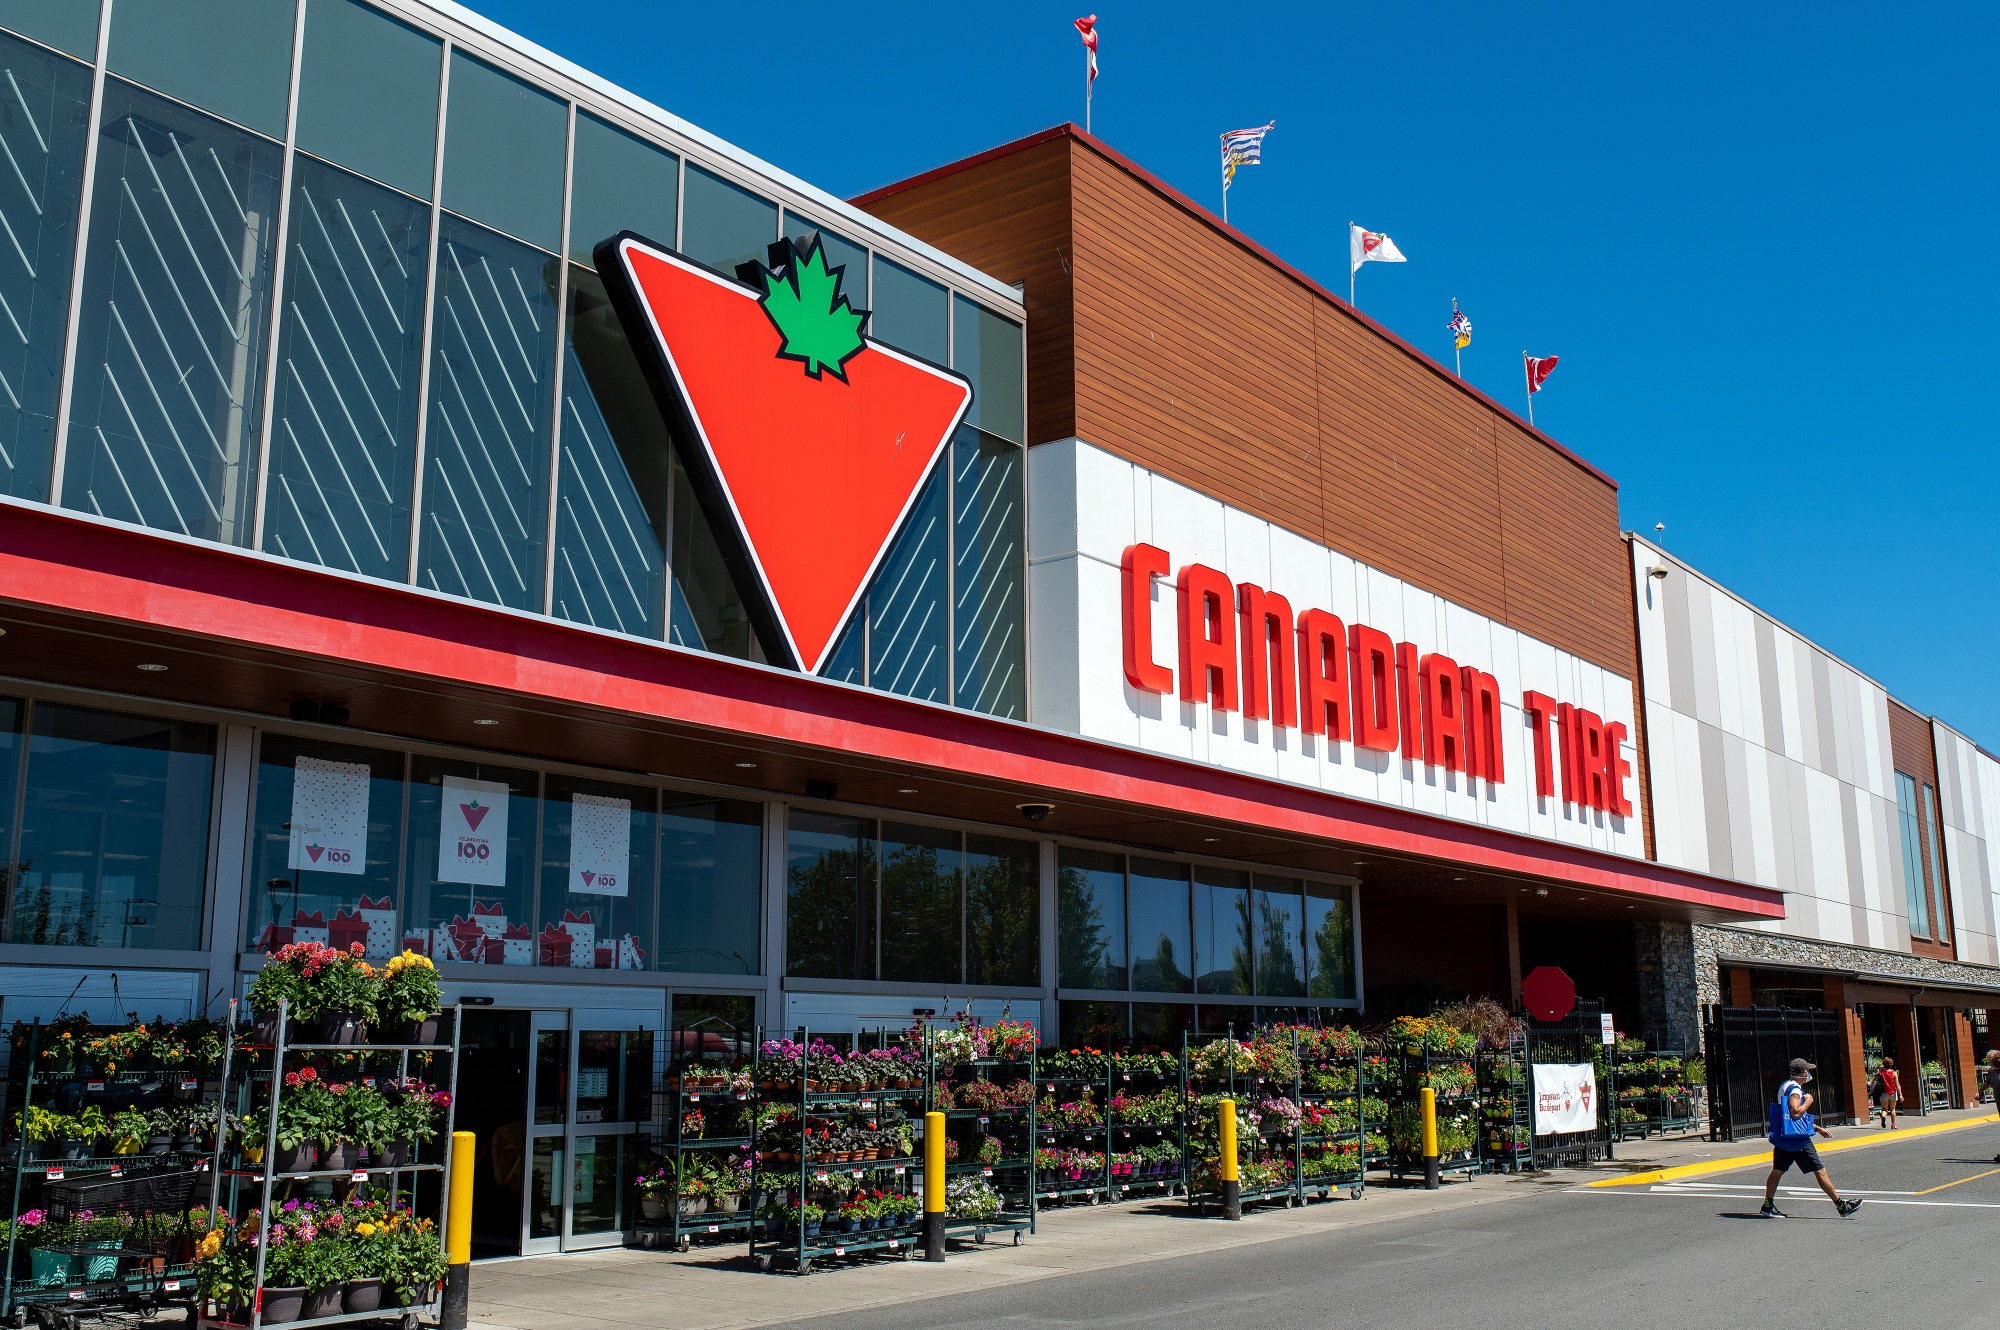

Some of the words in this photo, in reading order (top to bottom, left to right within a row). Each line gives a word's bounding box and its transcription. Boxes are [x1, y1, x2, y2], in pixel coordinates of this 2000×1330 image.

[1120, 543, 1505, 785] CANADIAN
[1523, 689, 1633, 819] TIRE
[458, 836, 489, 844] CELEBRATING
[457, 841, 490, 860] 100
[327, 851, 351, 864] 100
[598, 876, 617, 887] 100
